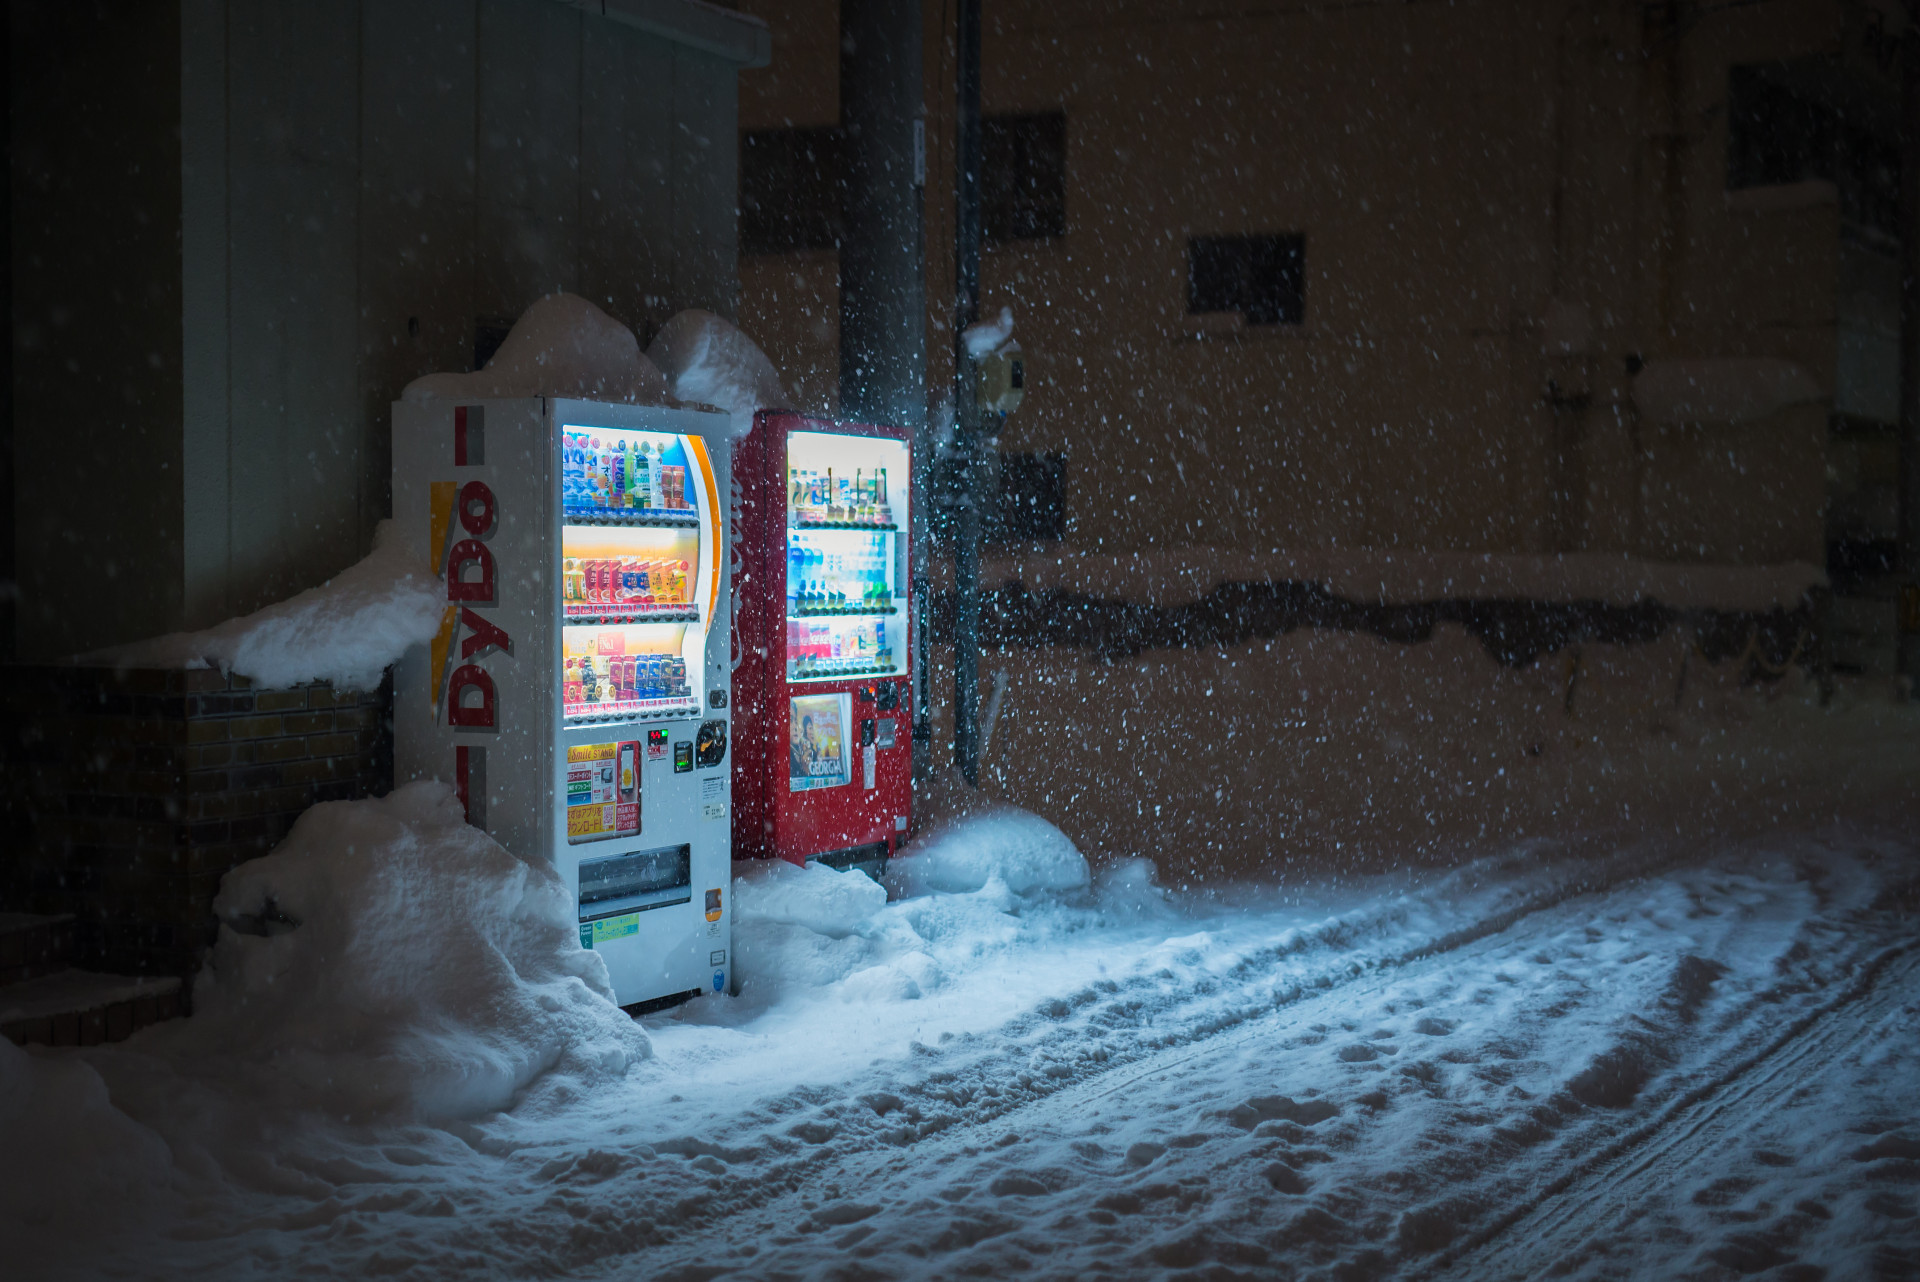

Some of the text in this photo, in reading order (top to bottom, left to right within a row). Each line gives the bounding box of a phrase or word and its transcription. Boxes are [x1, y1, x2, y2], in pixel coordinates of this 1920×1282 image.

[448, 480, 510, 728] DyDo
[572, 748, 613, 760] Smile STAND
[808, 760, 842, 776] GEORGIA
